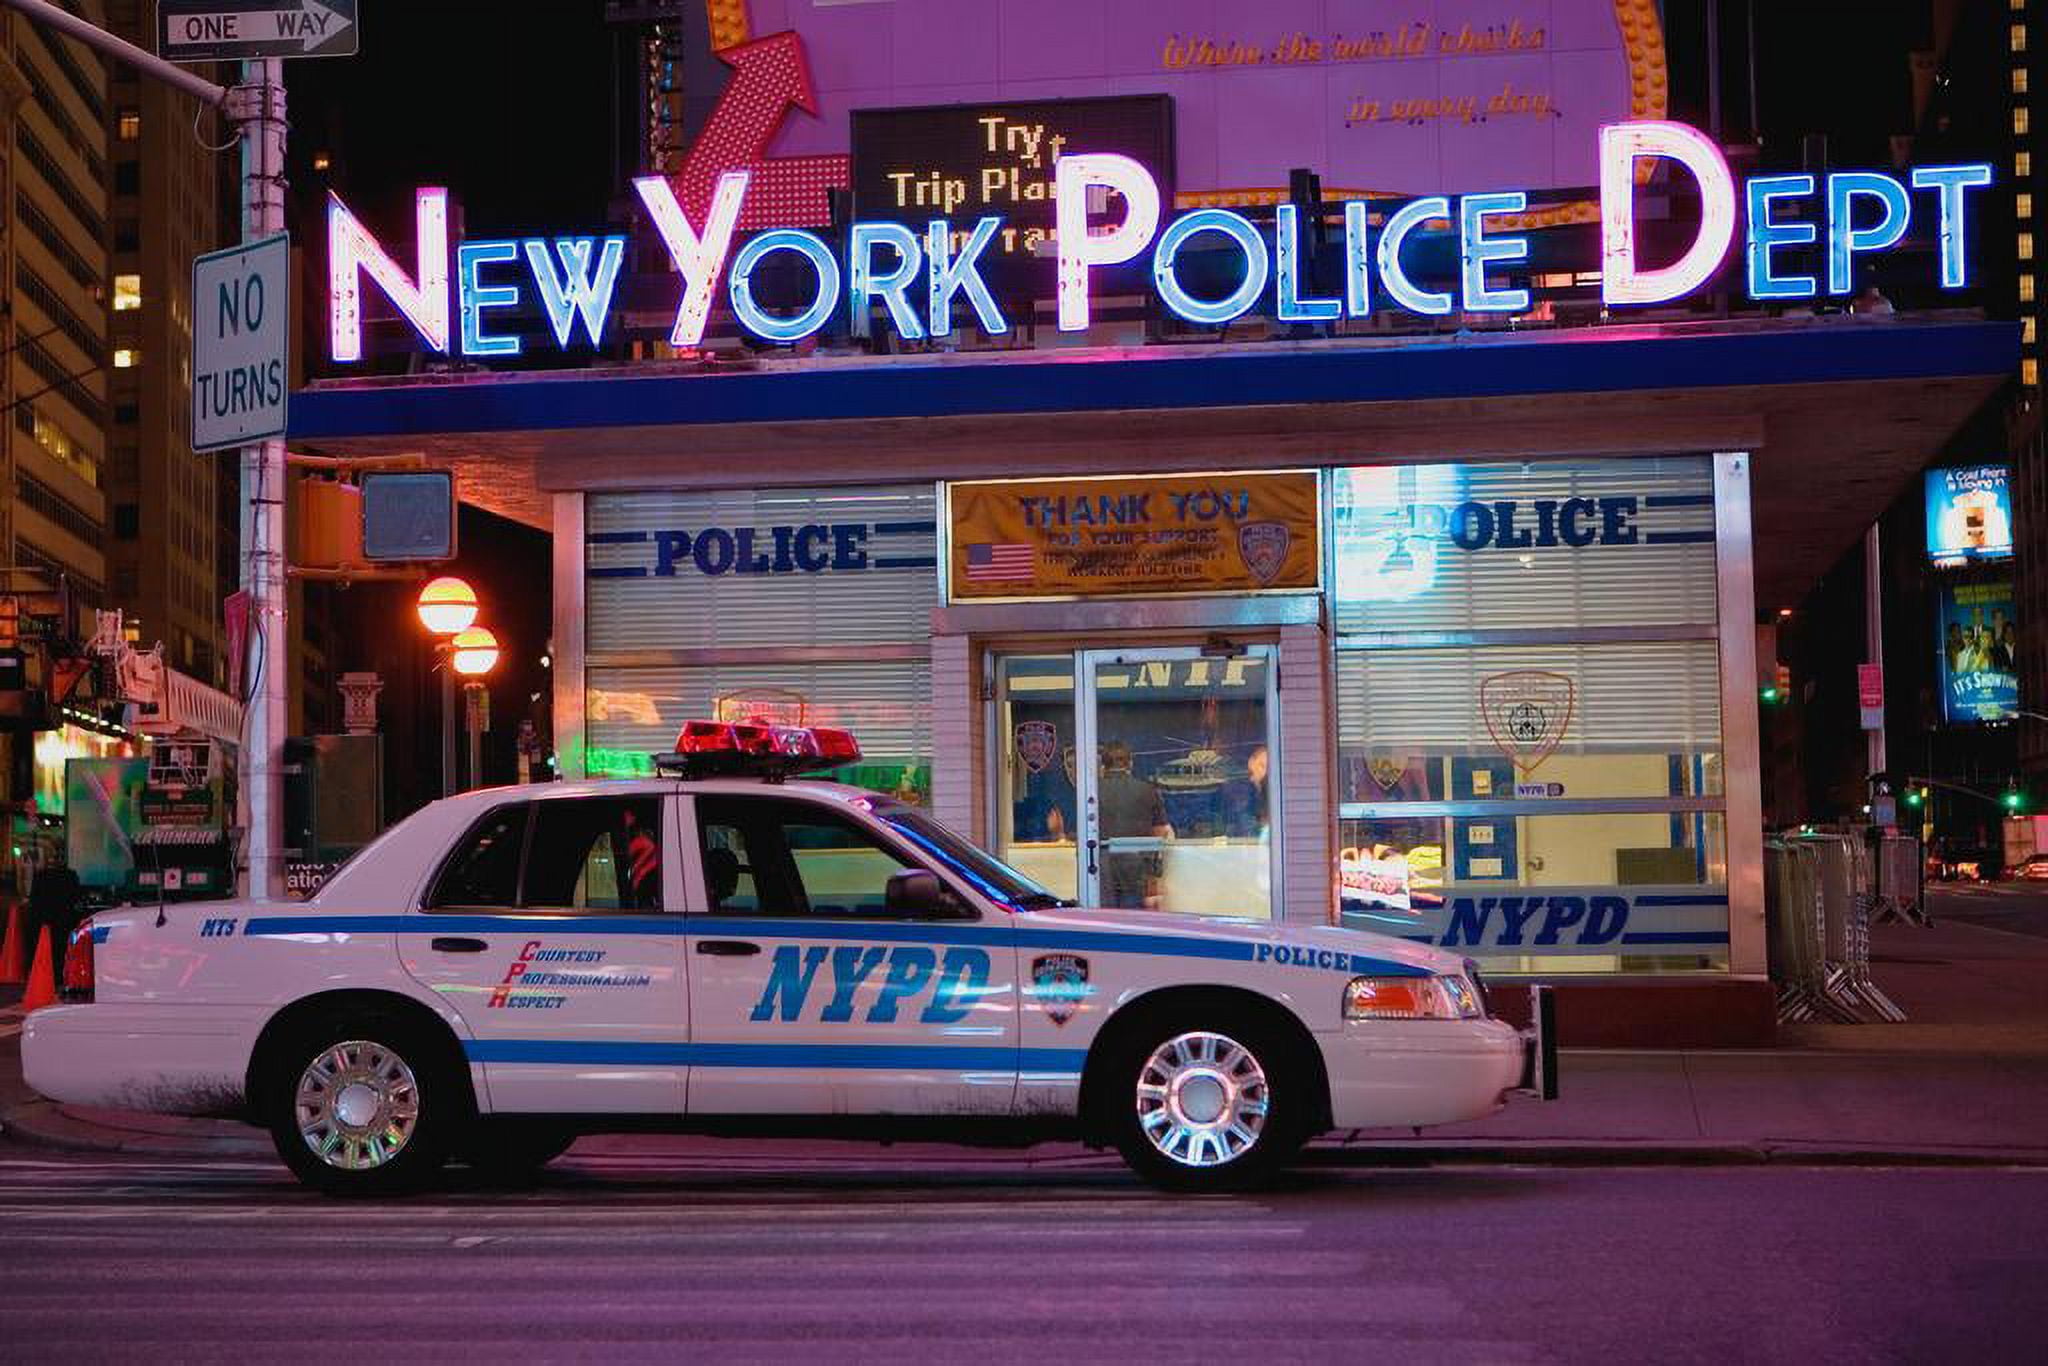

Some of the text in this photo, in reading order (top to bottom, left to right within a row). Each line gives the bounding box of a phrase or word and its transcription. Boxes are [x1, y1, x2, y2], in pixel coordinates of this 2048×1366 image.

[185, 12, 331, 41] ONE WAY
[979, 117, 1044, 163] Try
[887, 171, 965, 214] Trip
[218, 273, 264, 339] NO
[197, 358, 282, 420] TURNS
[1018, 487, 1250, 526] THANK YOU
[1406, 497, 1639, 551] POLICE
[654, 524, 867, 576] POLICE
[1090, 529, 1136, 546] YOUR
[1141, 527, 1220, 545] SUPPORT
[1440, 895, 1629, 947] NYPD
[1254, 943, 1351, 972] POLICE
[750, 944, 991, 1023] NYPD
